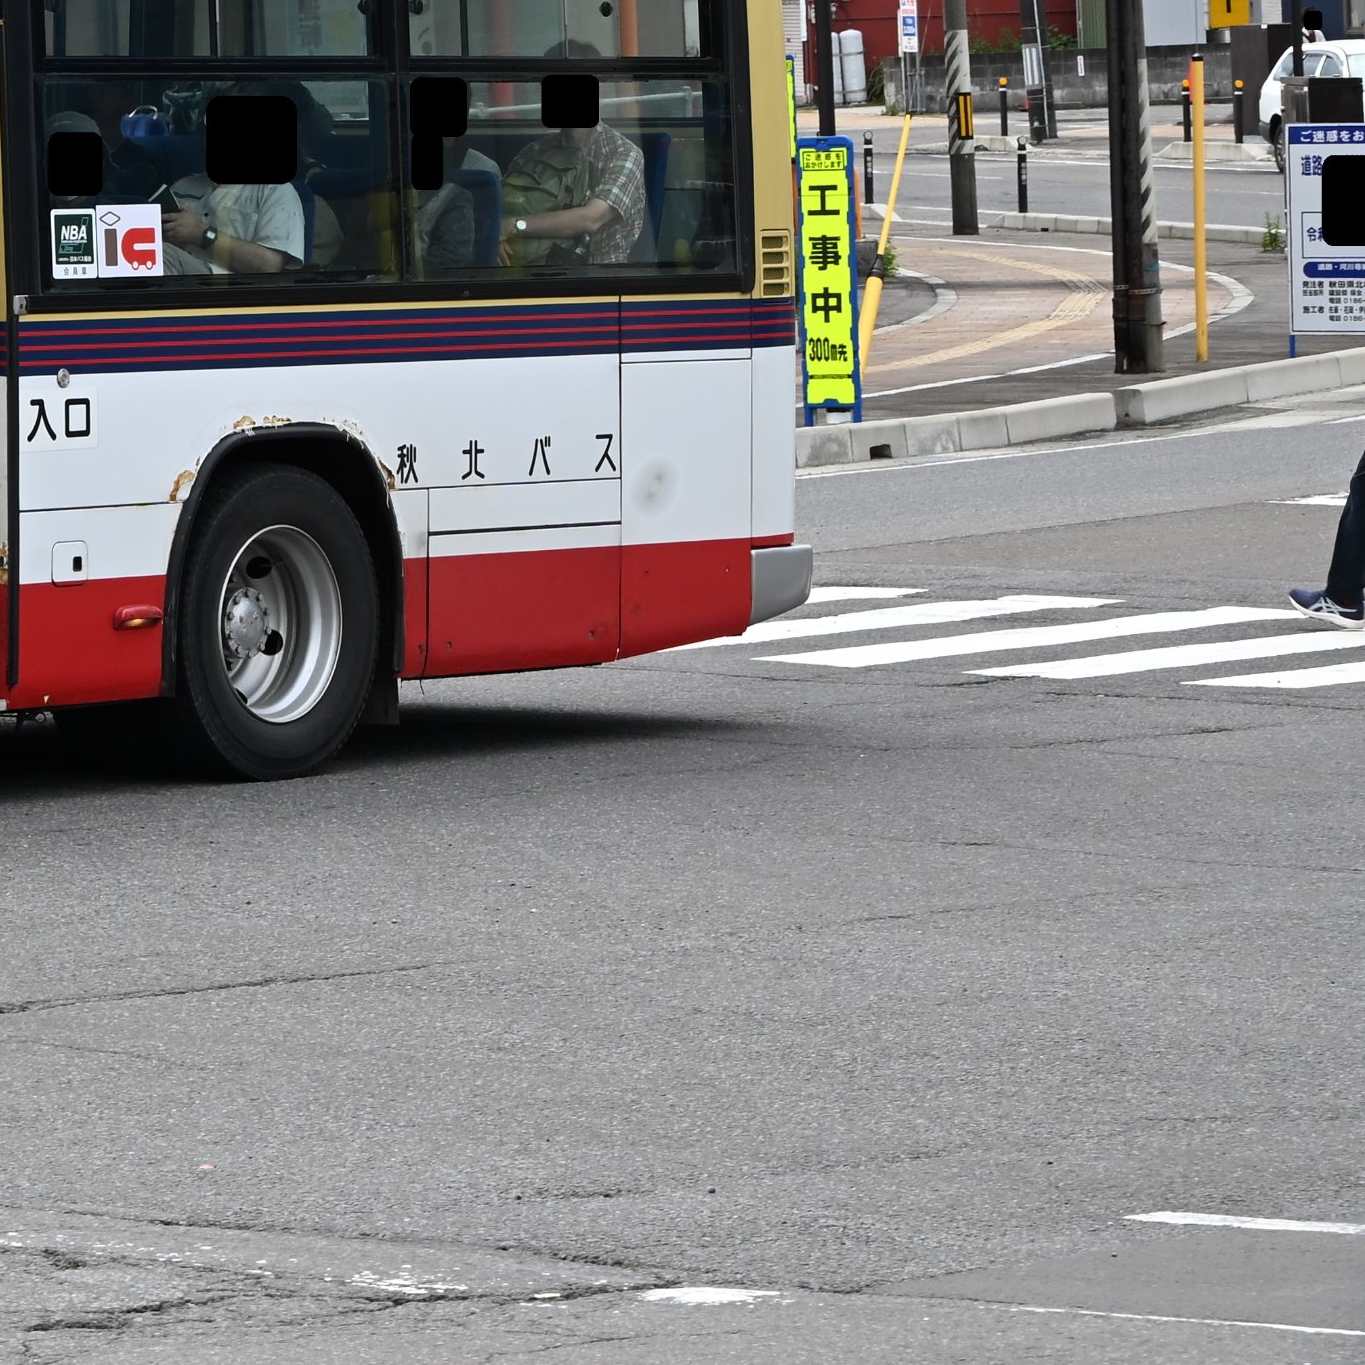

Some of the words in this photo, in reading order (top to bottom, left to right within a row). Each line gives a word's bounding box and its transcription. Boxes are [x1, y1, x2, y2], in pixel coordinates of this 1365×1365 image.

[61, 226, 87, 240] NBA
[807, 185, 842, 323] 工事中
[1329, 280, 1365, 289] 秋田県北
[26, 397, 91, 443] 入口
[396, 434, 617, 485] 秋北バス
